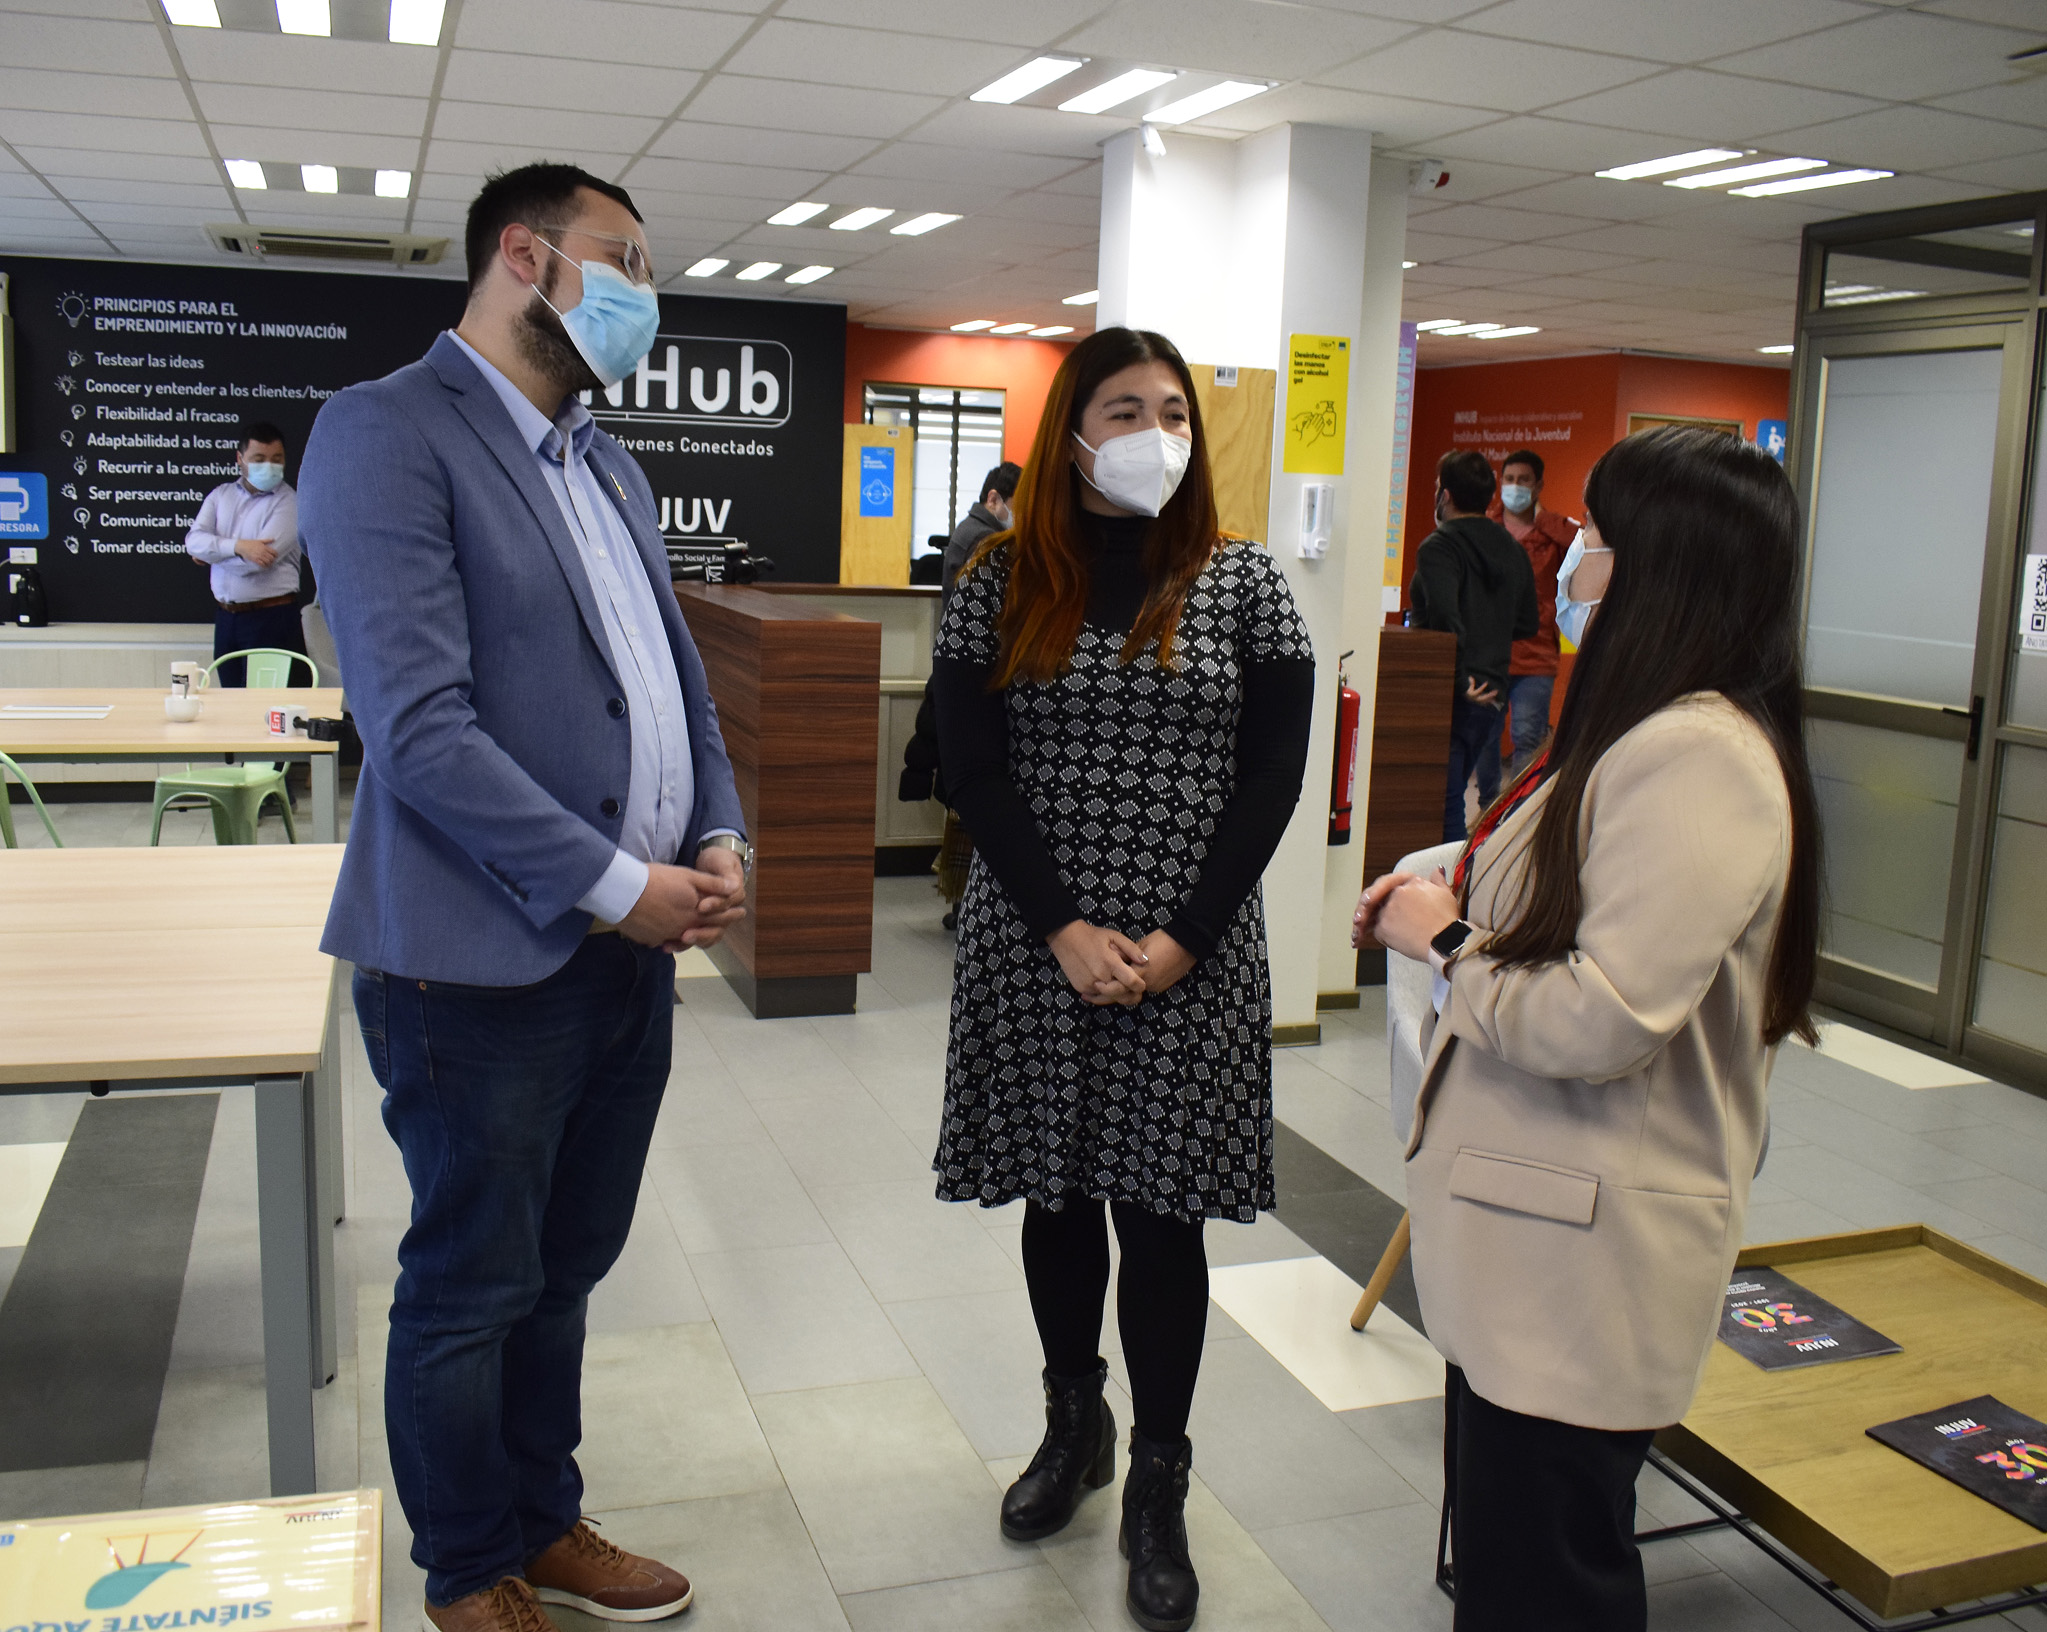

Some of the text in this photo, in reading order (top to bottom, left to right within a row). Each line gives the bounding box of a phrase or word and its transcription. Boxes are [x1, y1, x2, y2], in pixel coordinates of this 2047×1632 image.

[94, 297, 238, 316] PRINCIPIOS PARA EL
[94, 317, 347, 340] EMPRENDIMIENTO Y LA INNOVACIÓN
[95, 352, 205, 369] Testear las ideas
[1294, 351, 1331, 360] Desinfectar
[86, 379, 141, 394] Conocer
[144, 384, 153, 397] y
[155, 381, 217, 396] entender
[219, 386, 227, 396] a
[230, 383, 249, 397] los
[96, 406, 240, 423] Flexibilidad al fracaso
[87, 433, 180, 450] Adaptabilidad
[182, 439, 190, 448] a
[193, 435, 212, 449] los
[1483, 428, 1514, 442] Nacional
[1514, 428, 1524, 441] de
[1533, 426, 1572, 441] Juventud
[609, 433, 774, 456] óvenes Conectados
[98, 459, 153, 474] Recurrir
[156, 465, 164, 474] a
[167, 461, 179, 475] la
[88, 486, 203, 503] Ser perseverante
[100, 513, 172, 527] Comunicar
[90, 540, 133, 553] Tomar
[684, 554, 705, 562] Social
[706, 555, 712, 564] y
[1731, 1302, 1815, 1329] 30
[1795, 1337, 1840, 1353] INJUV
[1934, 1417, 1978, 1435] INJUV
[99, 1600, 272, 1632] SIÉNTATE
